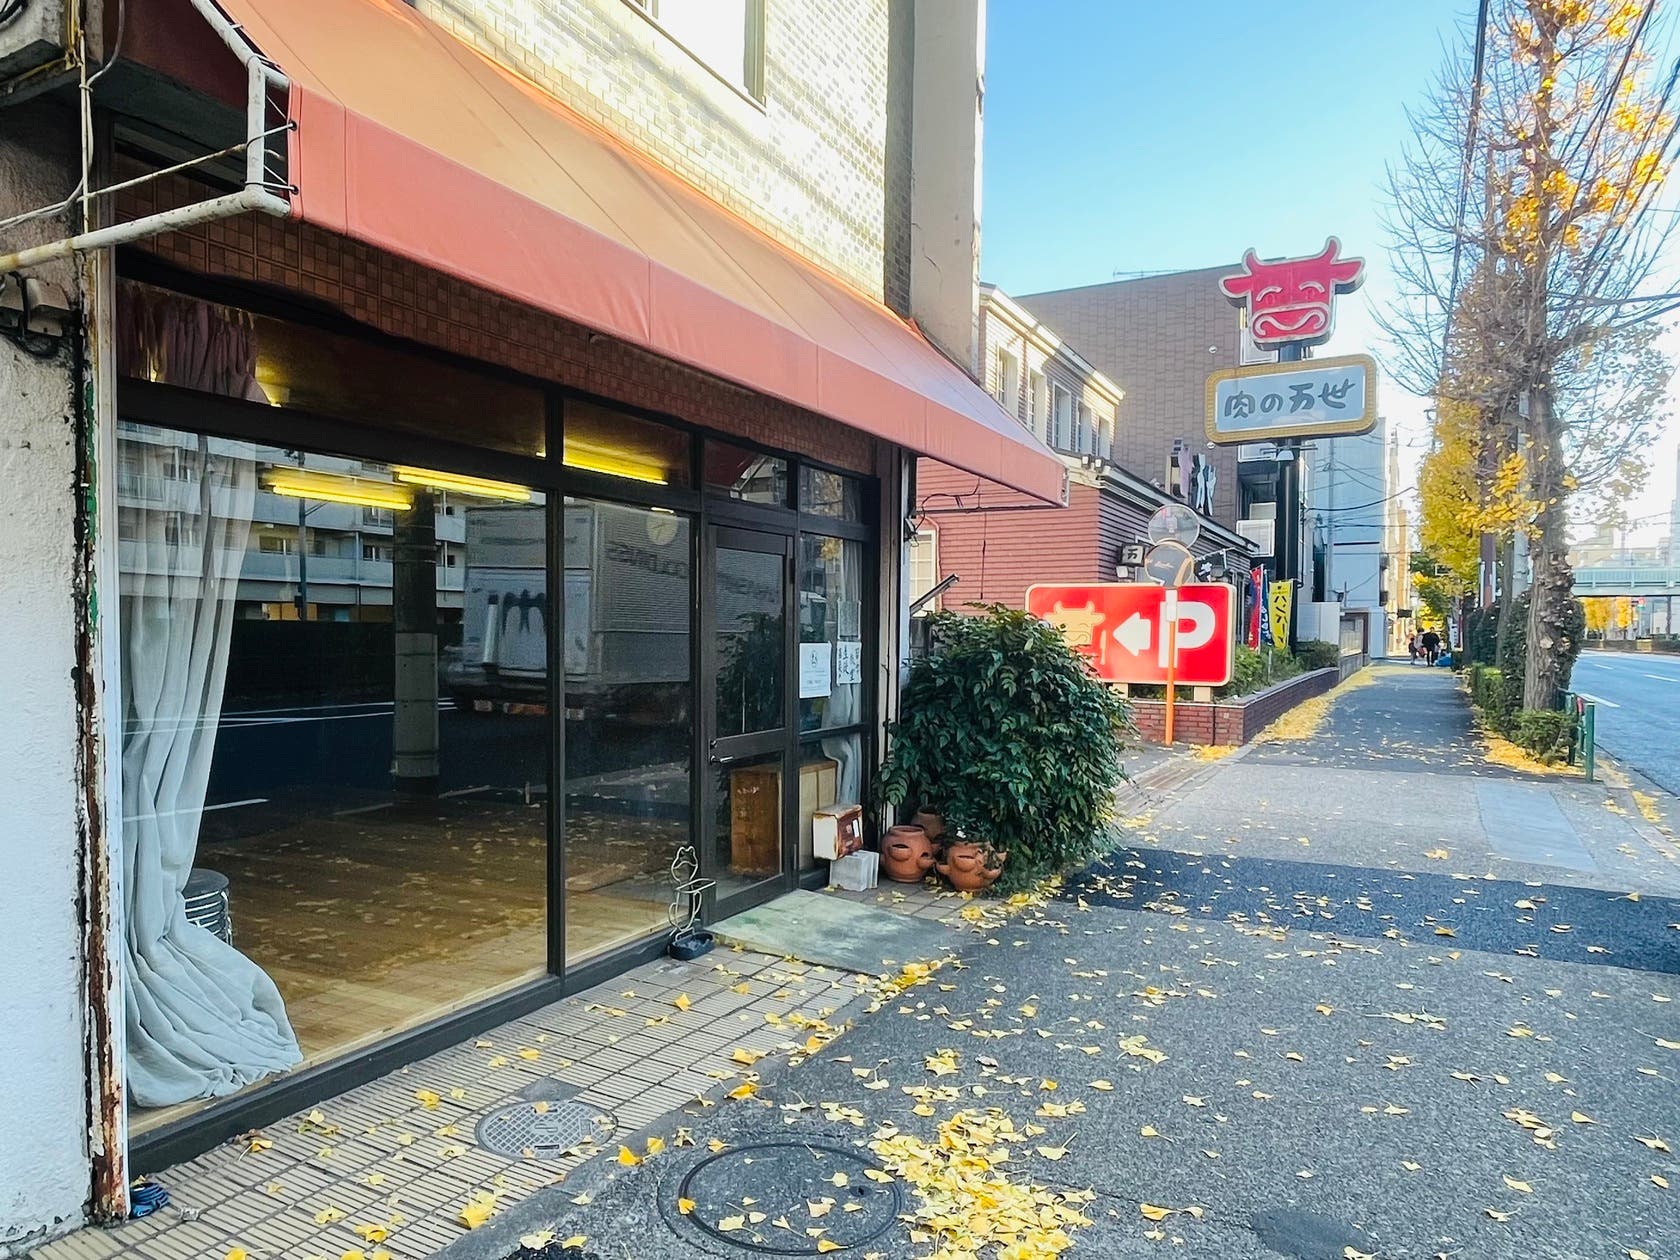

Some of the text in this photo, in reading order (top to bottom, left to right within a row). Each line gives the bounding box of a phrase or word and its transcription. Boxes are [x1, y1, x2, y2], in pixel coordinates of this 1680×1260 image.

[1224, 378, 1356, 419] 肉の万世
[1158, 600, 1216, 668] P
